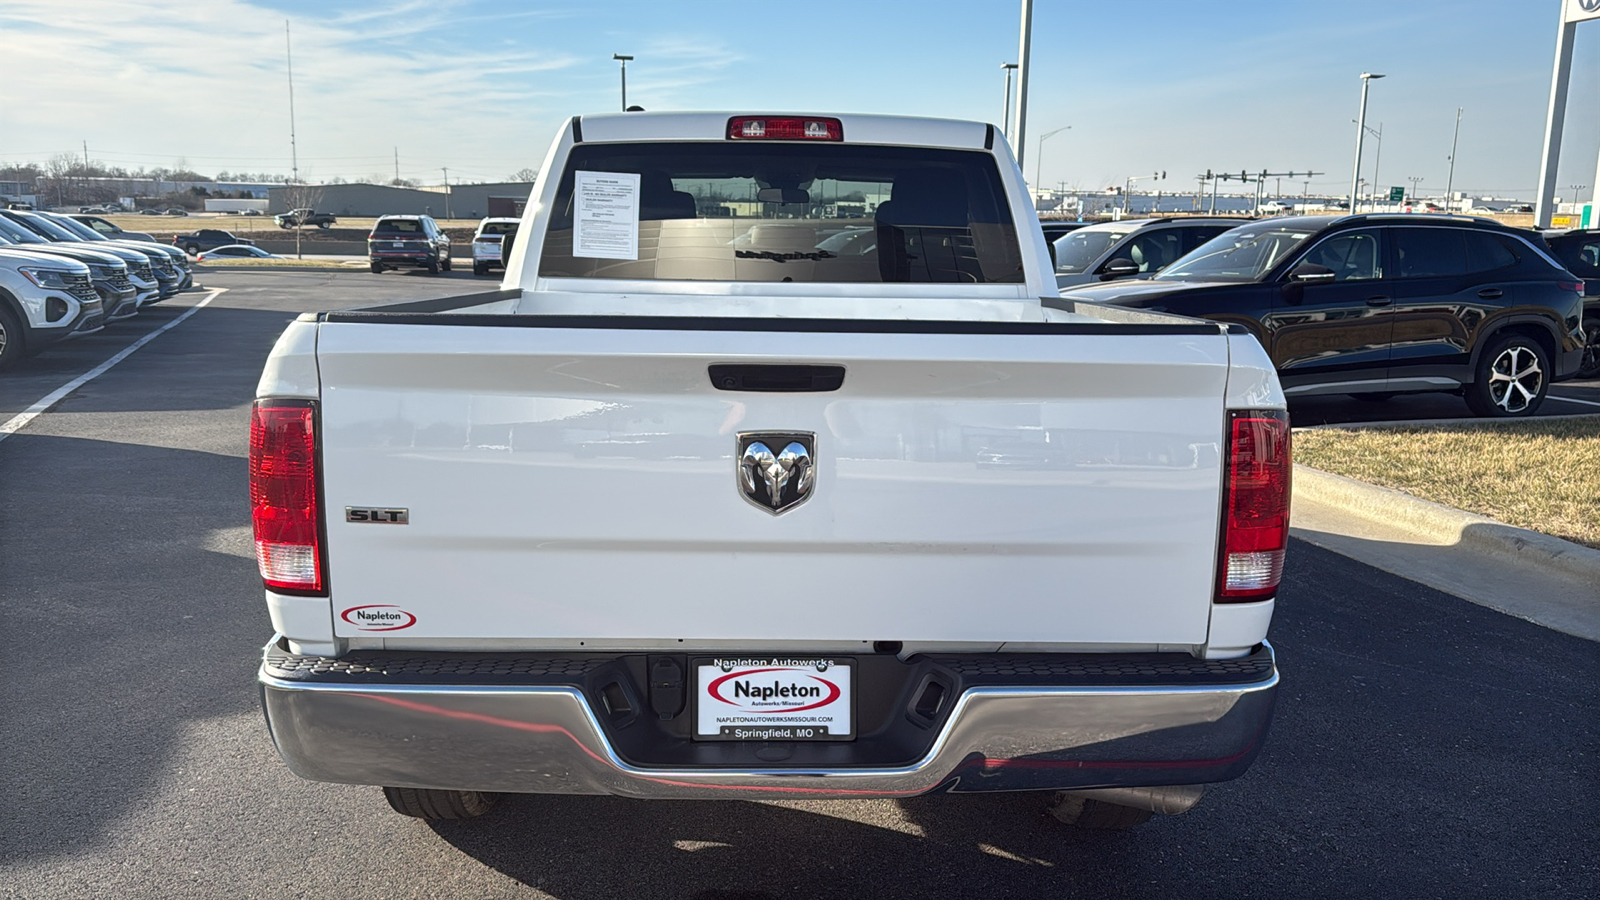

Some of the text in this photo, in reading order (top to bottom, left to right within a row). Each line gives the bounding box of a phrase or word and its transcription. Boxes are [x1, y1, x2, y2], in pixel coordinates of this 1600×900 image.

[350, 510, 403, 522] SLT
[357, 610, 401, 622] Napleton
[713, 658, 835, 667] Napleton Autowerks
[734, 680, 820, 701] Napleton
[734, 728, 814, 739] Springfield, MO
